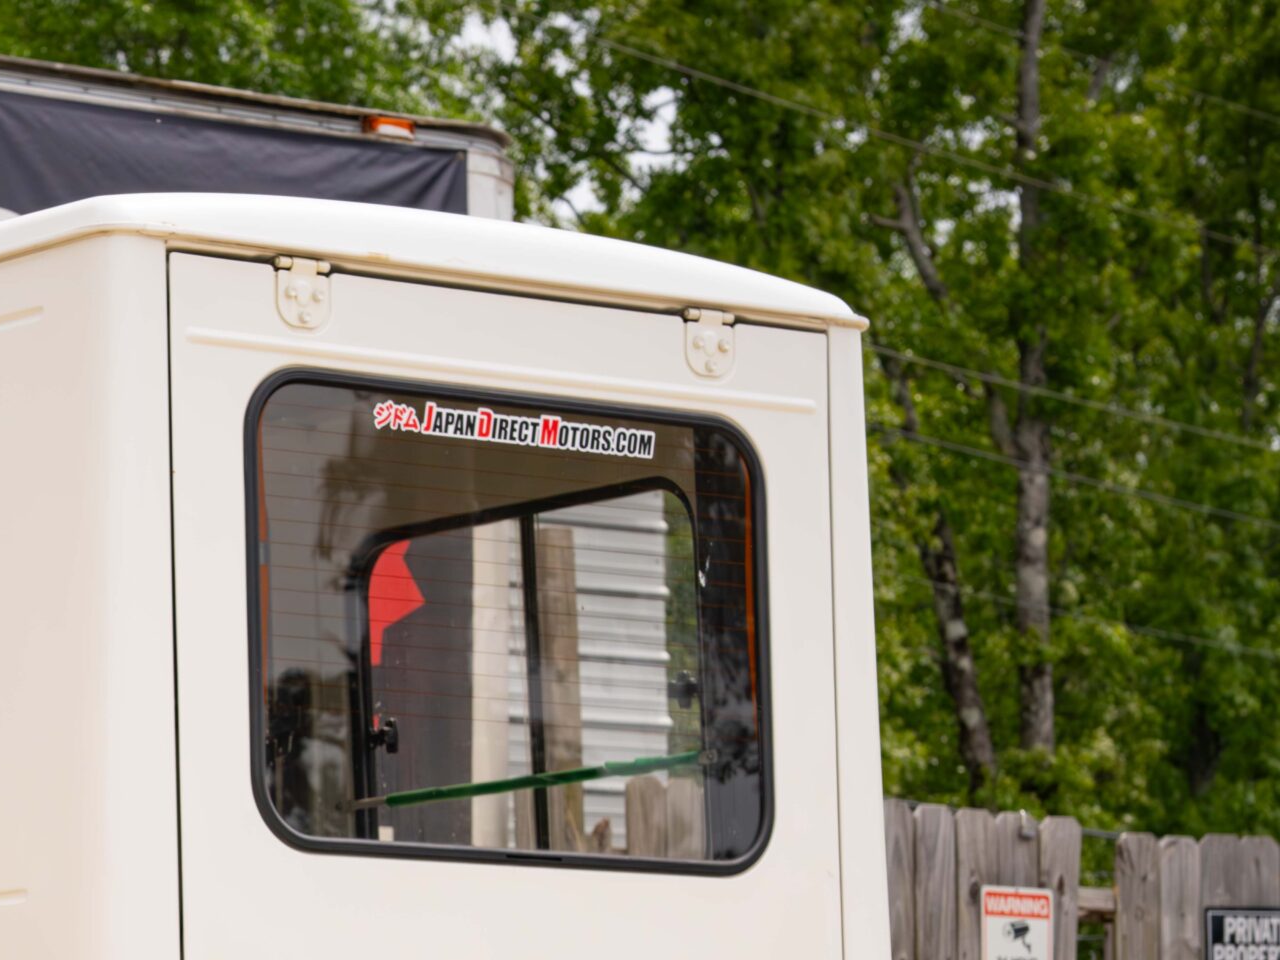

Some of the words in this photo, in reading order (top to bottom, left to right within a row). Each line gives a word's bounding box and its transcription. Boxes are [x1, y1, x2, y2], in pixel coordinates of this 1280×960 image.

[375, 402, 419, 430] ジドム
[423, 404, 653, 456] JAPANDIRECTMOTORS.COM
[985, 894, 1049, 917] WARNING
